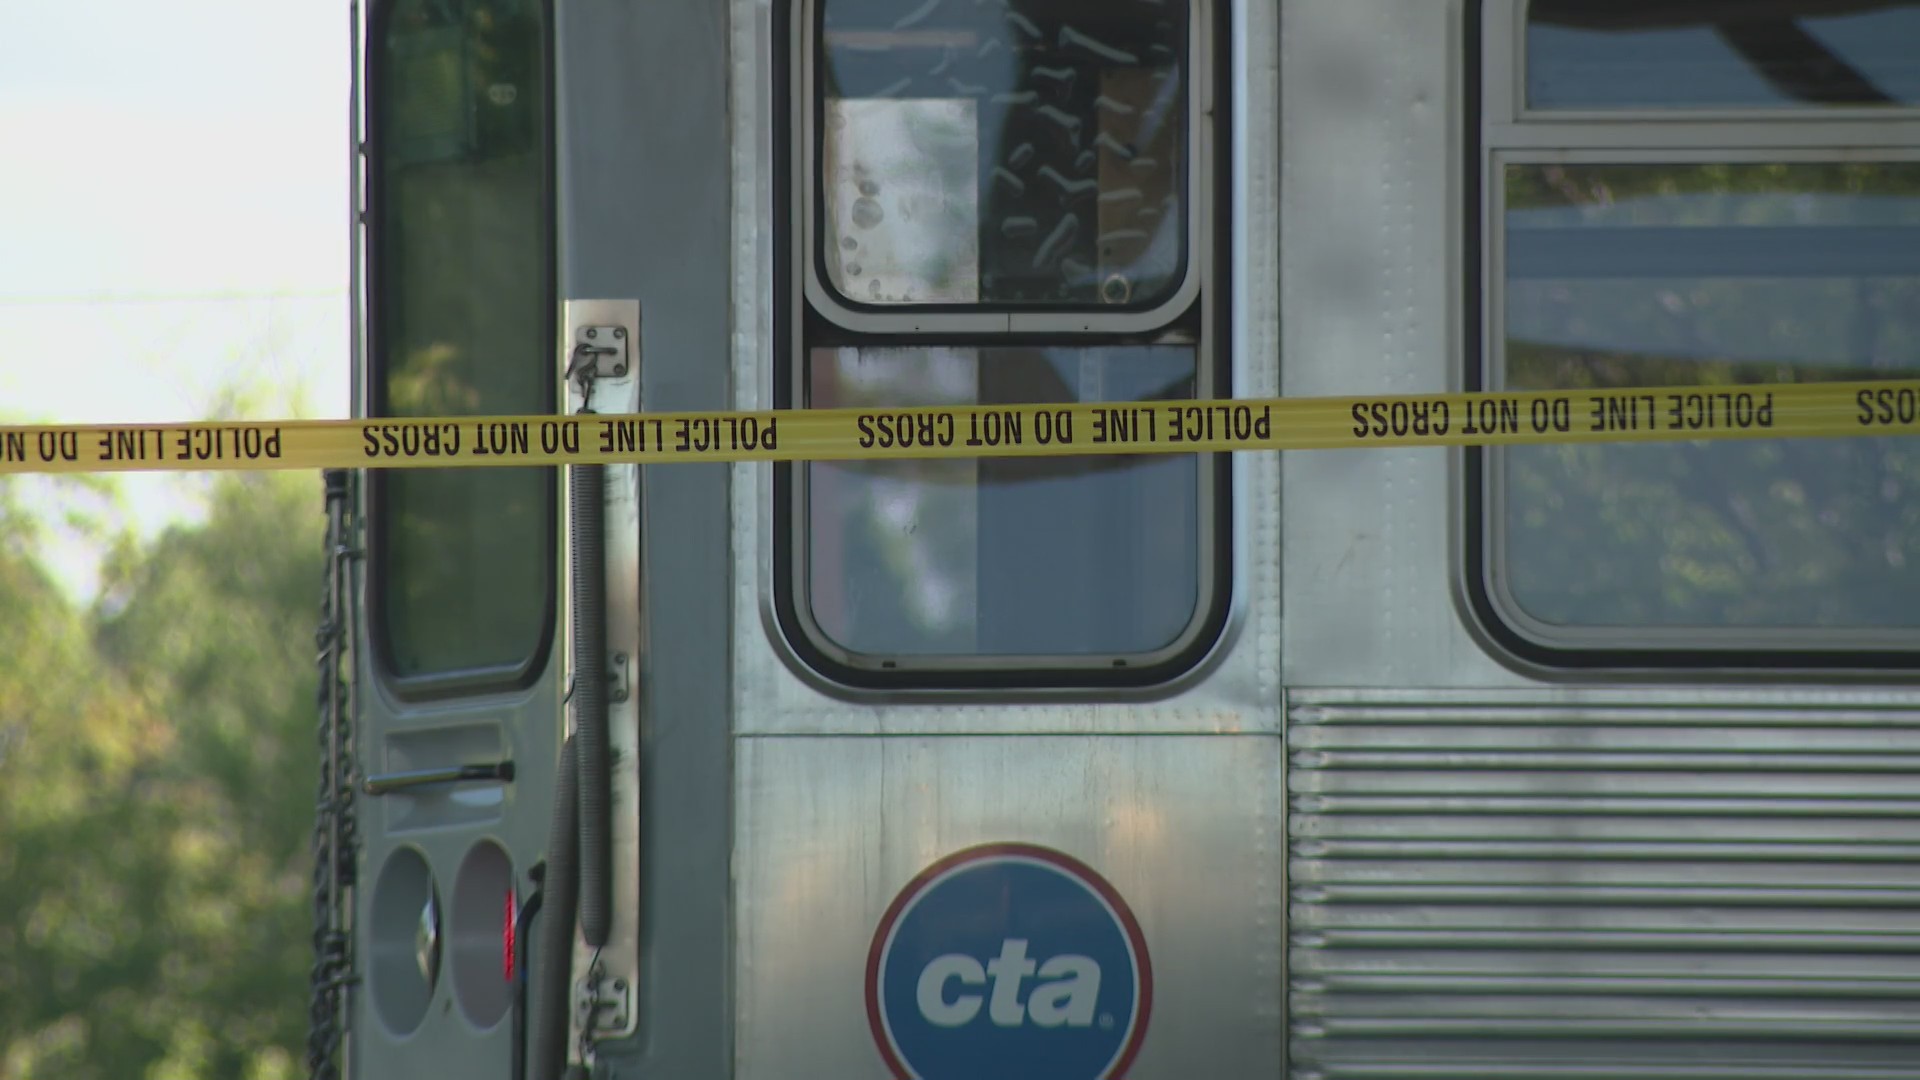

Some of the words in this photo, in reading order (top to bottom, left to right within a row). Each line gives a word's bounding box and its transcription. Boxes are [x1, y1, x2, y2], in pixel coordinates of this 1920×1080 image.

[1167, 405, 1271, 442] POLICE
[1351, 400, 1449, 438] CROSS
[1461, 399, 1518, 434] NOT
[1531, 397, 1570, 434] DO
[1589, 394, 1655, 431] LINE
[1667, 392, 1773, 430] POLICE
[1856, 387, 1920, 426] OSS
[362, 423, 461, 457] CROSS
[472, 422, 529, 455] NOT
[541, 421, 580, 455] DO
[598, 419, 663, 453] LINE
[674, 416, 777, 452] POLICE
[857, 412, 954, 449] CROSS
[966, 411, 1022, 446] NOT
[1034, 410, 1073, 445] DO
[1091, 408, 1156, 443] LINE
[38, 431, 78, 462] DO
[99, 429, 164, 461] LINE
[177, 427, 281, 460] POLICE
[916, 938, 1101, 1028] cta
